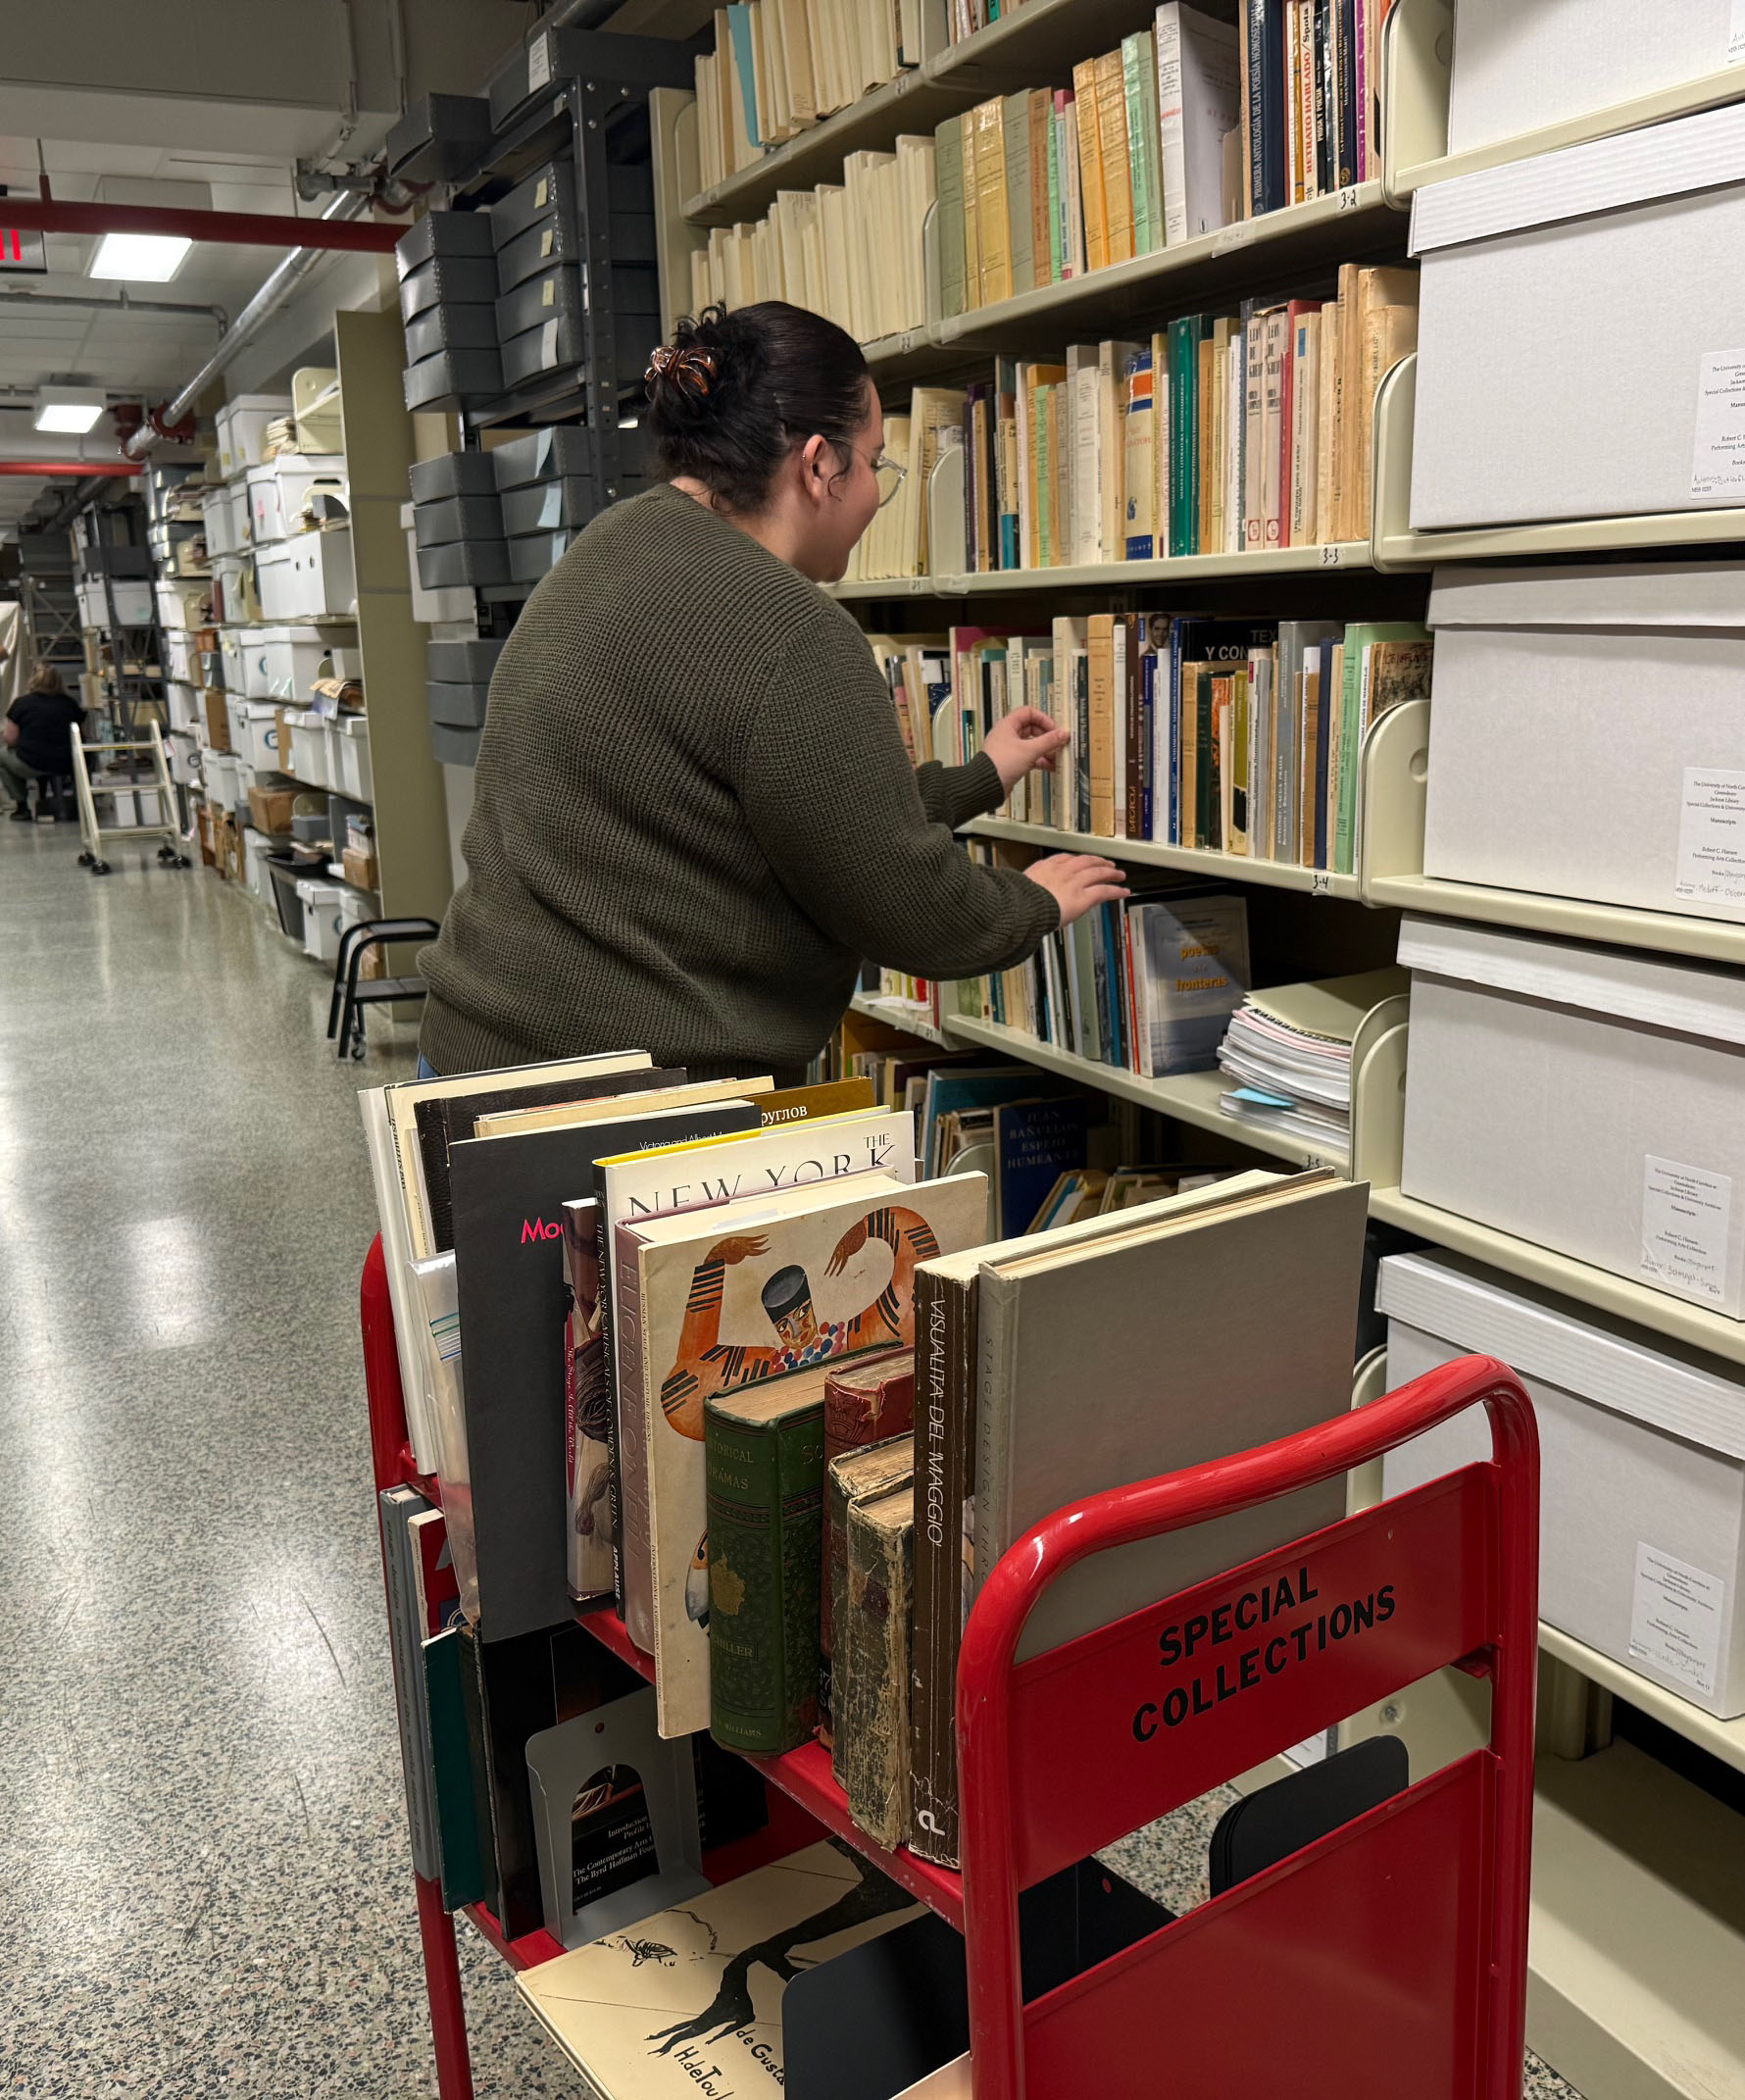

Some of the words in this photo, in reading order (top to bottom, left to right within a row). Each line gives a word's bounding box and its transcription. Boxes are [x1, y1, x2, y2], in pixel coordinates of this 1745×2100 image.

[1252, 92, 1262, 104] LA
[1252, 105, 1262, 120] DE
[1303, 120, 1313, 174] RETRATO
[1252, 165, 1263, 199] PRIMERA
[1340, 189, 1357, 209] 3-2
[1323, 548, 1339, 564] 3-3
[1251, 629, 1278, 643] TEX
[1206, 646, 1215, 660] Y
[1219, 646, 1249, 661] CON
[1313, 875, 1329, 889] 3-4
[1176, 975, 1228, 991] fronteras
[761, 1105, 808, 1126] руглов
[864, 1133, 890, 1149] THE
[1008, 1151, 1078, 1170] HUMEANTE
[628, 1175, 741, 1216] NEW
[597, 1250, 606, 1281] NEW
[599, 1282, 608, 1323] YORK
[602, 1325, 612, 1385] MUSICALS
[619, 1263, 638, 1420] EUGENE
[983, 1338, 994, 1409] STAGE
[605, 1389, 613, 1409] OF
[607, 1409, 616, 1468] COMDEN
[928, 1405, 945, 1442] DEL
[981, 1422, 991, 1512] DESIGN
[613, 1545, 622, 1600] APPLAUSE
[1160, 1568, 1319, 1667] SPECIAL
[1132, 1584, 1395, 1743] COLLECTIONS
[573, 1868, 585, 1877] The
[587, 1845, 633, 1871] Contemporary
[634, 1839, 648, 1850] Arts
[575, 1875, 589, 1885] The
[590, 1865, 607, 1879] Byrd
[736, 2028, 757, 2045] de
